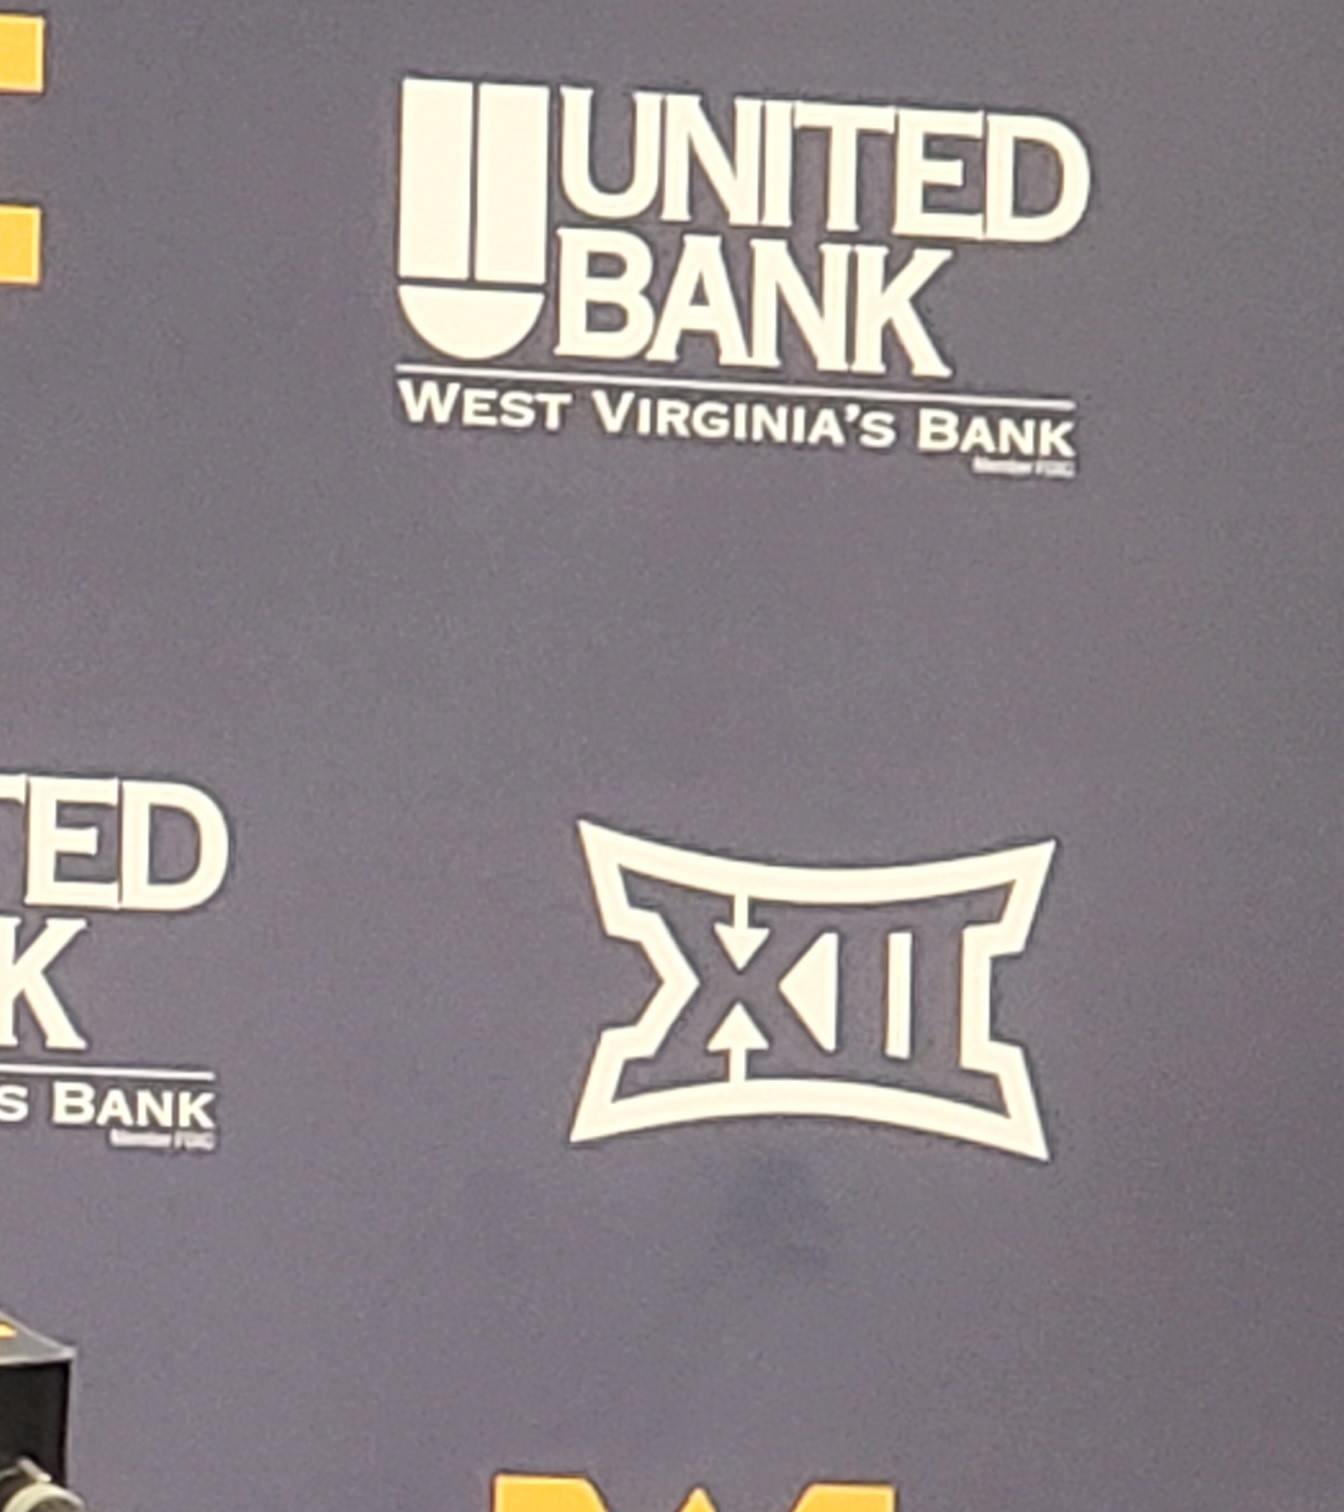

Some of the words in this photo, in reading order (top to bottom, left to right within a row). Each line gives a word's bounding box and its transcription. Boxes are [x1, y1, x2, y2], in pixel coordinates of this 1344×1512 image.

[559, 86, 1091, 243] UNITED
[554, 226, 953, 379] BANK
[397, 379, 572, 430] WEST
[591, 389, 896, 448] VIRGINIA'S
[918, 408, 1075, 457] BANK
[52, 1081, 215, 1129] BANK
